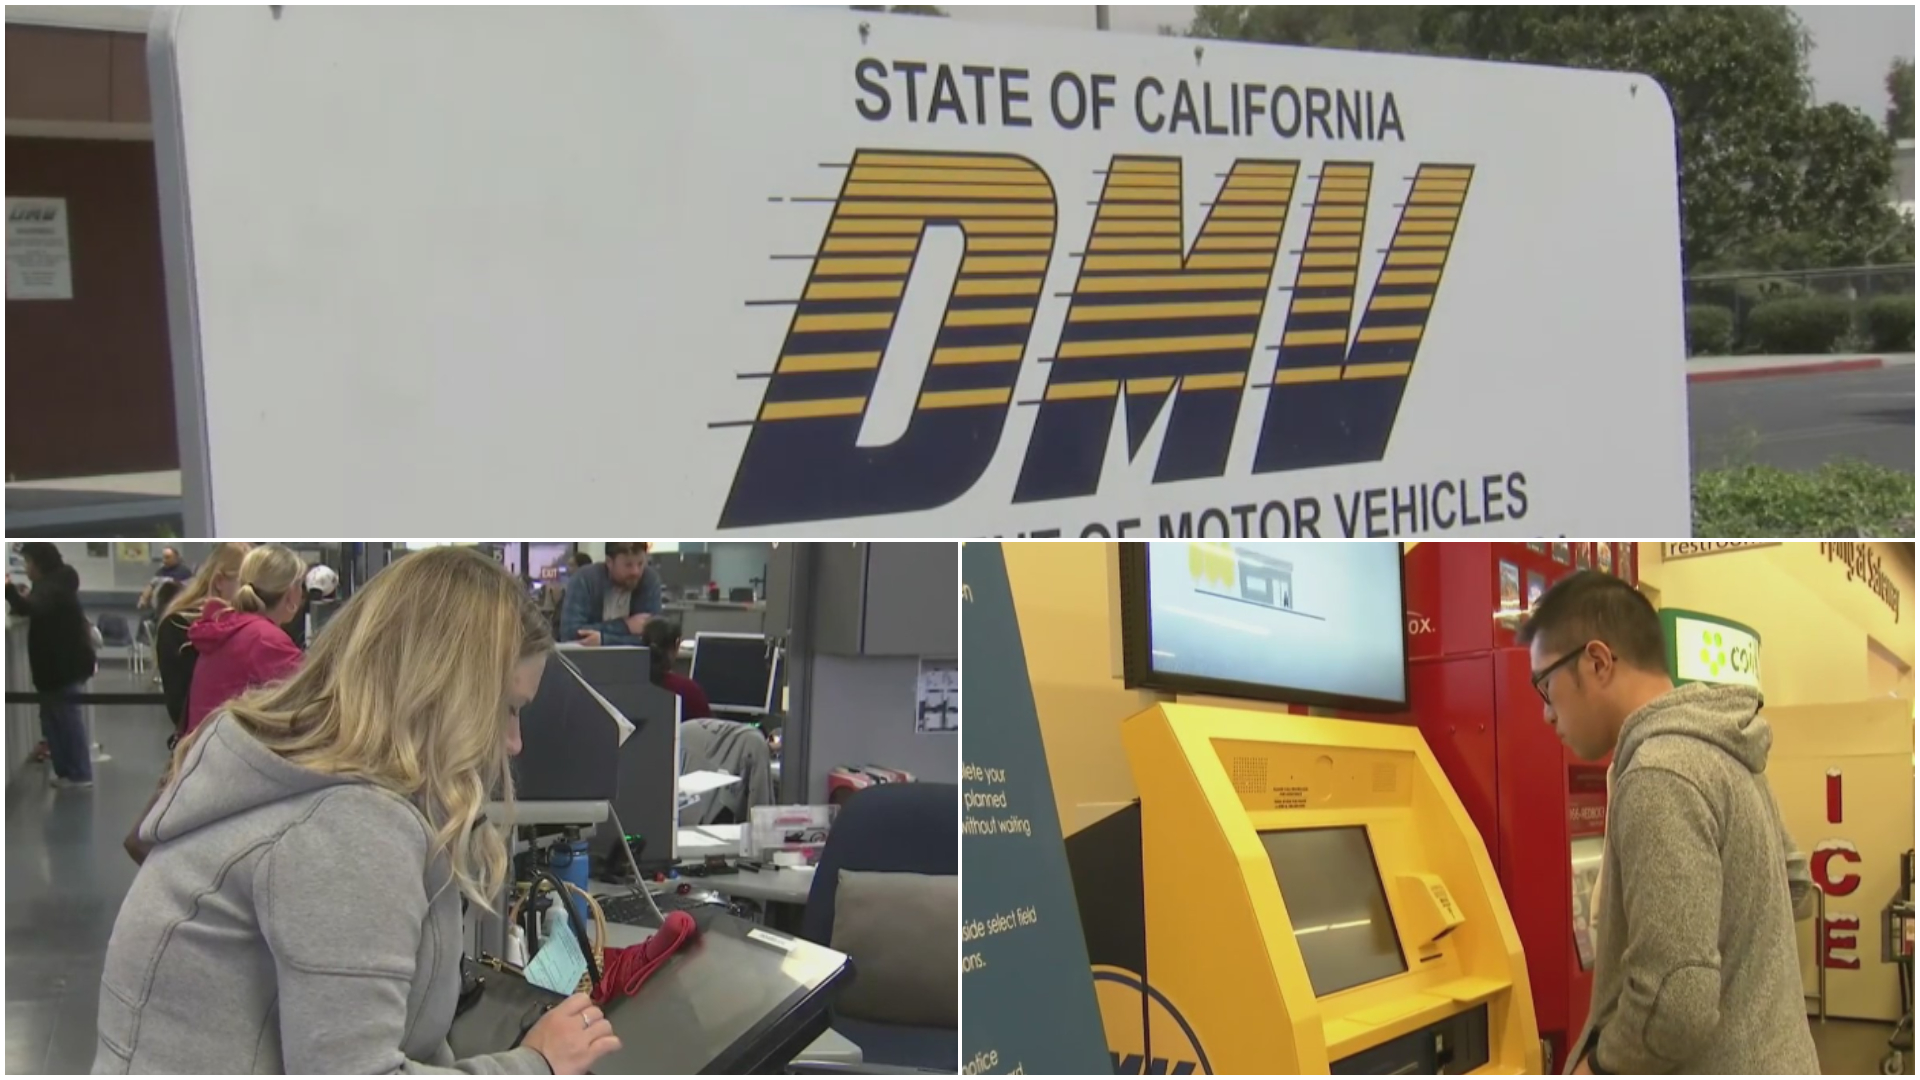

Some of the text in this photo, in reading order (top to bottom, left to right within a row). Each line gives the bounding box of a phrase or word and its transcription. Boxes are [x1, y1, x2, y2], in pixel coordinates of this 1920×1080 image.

[854, 57, 1406, 142] STATE OF CALIFORNIA
[717, 148, 1476, 529] DMV
[1334, 471, 1529, 538] VEHICLES
[542, 567, 557, 579] EXIT
[984, 767, 1006, 786] your
[964, 788, 1007, 812] planned
[962, 815, 1032, 837] without waiting
[1810, 766, 1862, 970] ICE
[962, 904, 1038, 941] side select field
[962, 1049, 999, 1075] notice
